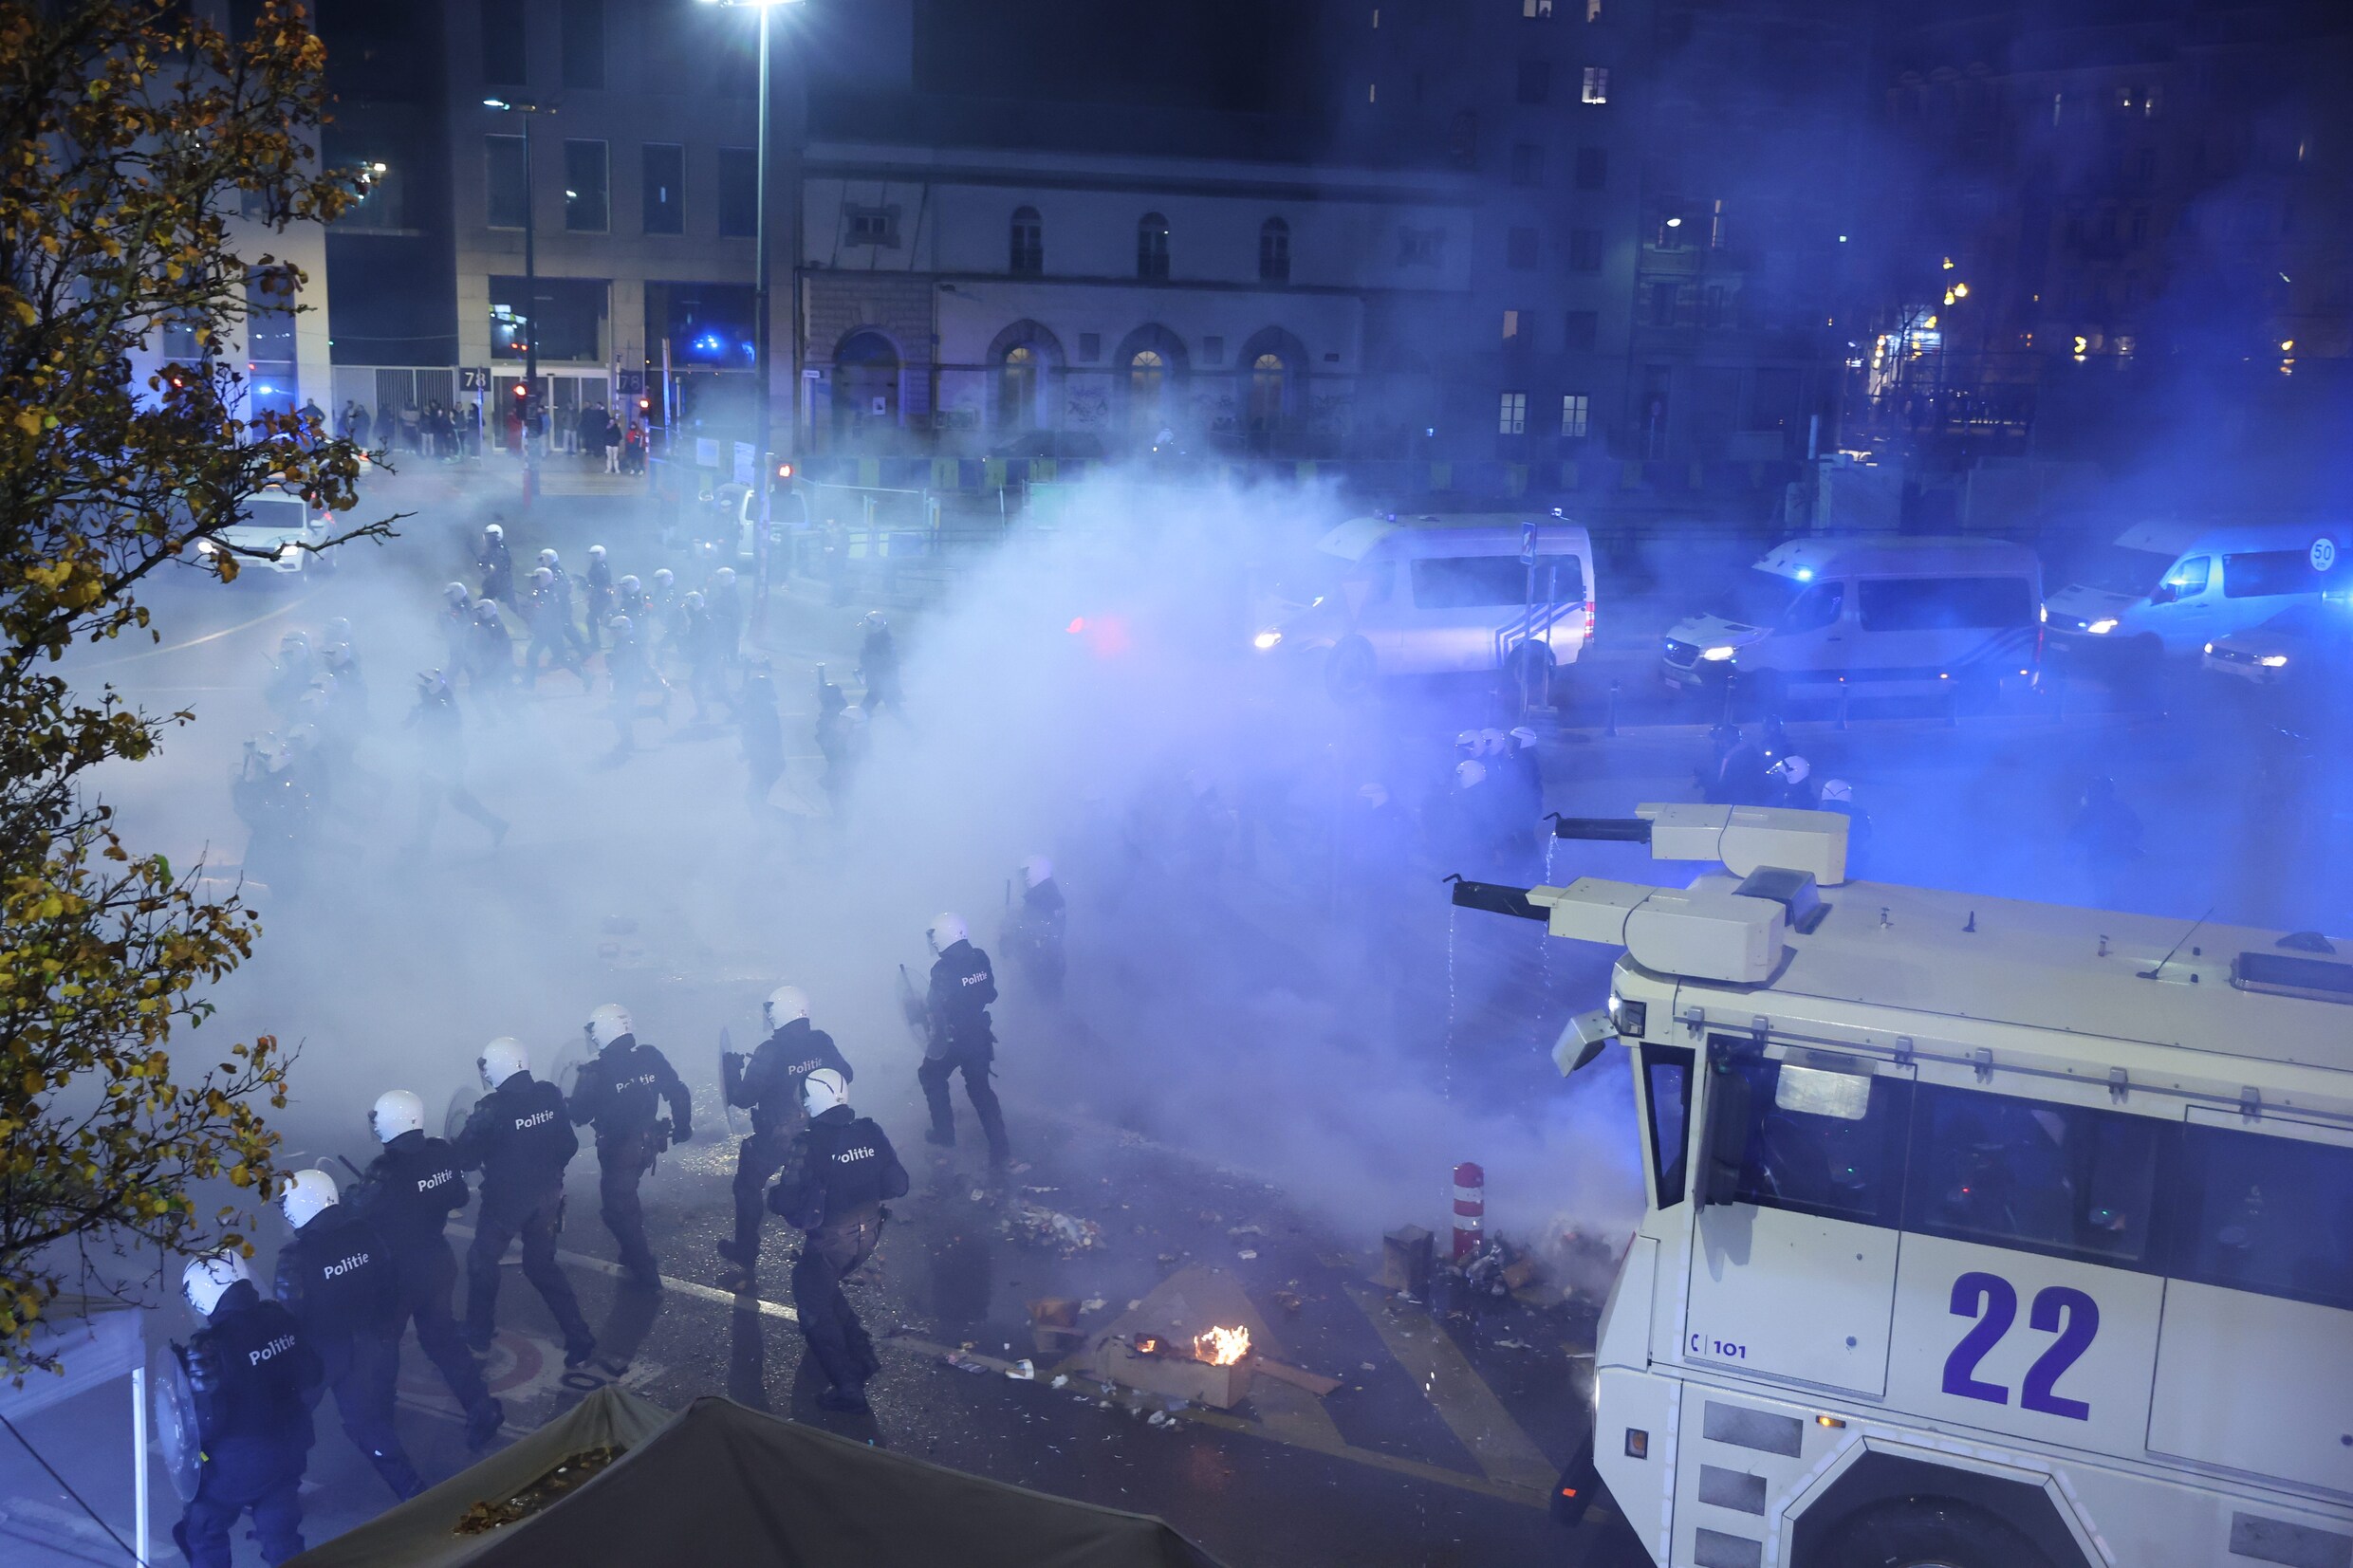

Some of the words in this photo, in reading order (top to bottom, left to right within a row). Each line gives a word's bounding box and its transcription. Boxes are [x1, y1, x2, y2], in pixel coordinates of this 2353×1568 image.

[464, 372, 487, 388] 78
[620, 375, 640, 390] 78
[2313, 544, 2332, 561] 50
[616, 1074, 656, 1094] Ptie
[515, 1109, 554, 1131] Politie
[417, 1169, 453, 1192] Politie
[324, 1252, 369, 1280] Politie
[249, 1334, 295, 1366] Politie
[1714, 1340, 1746, 1359] 101
[1941, 1271, 2100, 1422] 22
